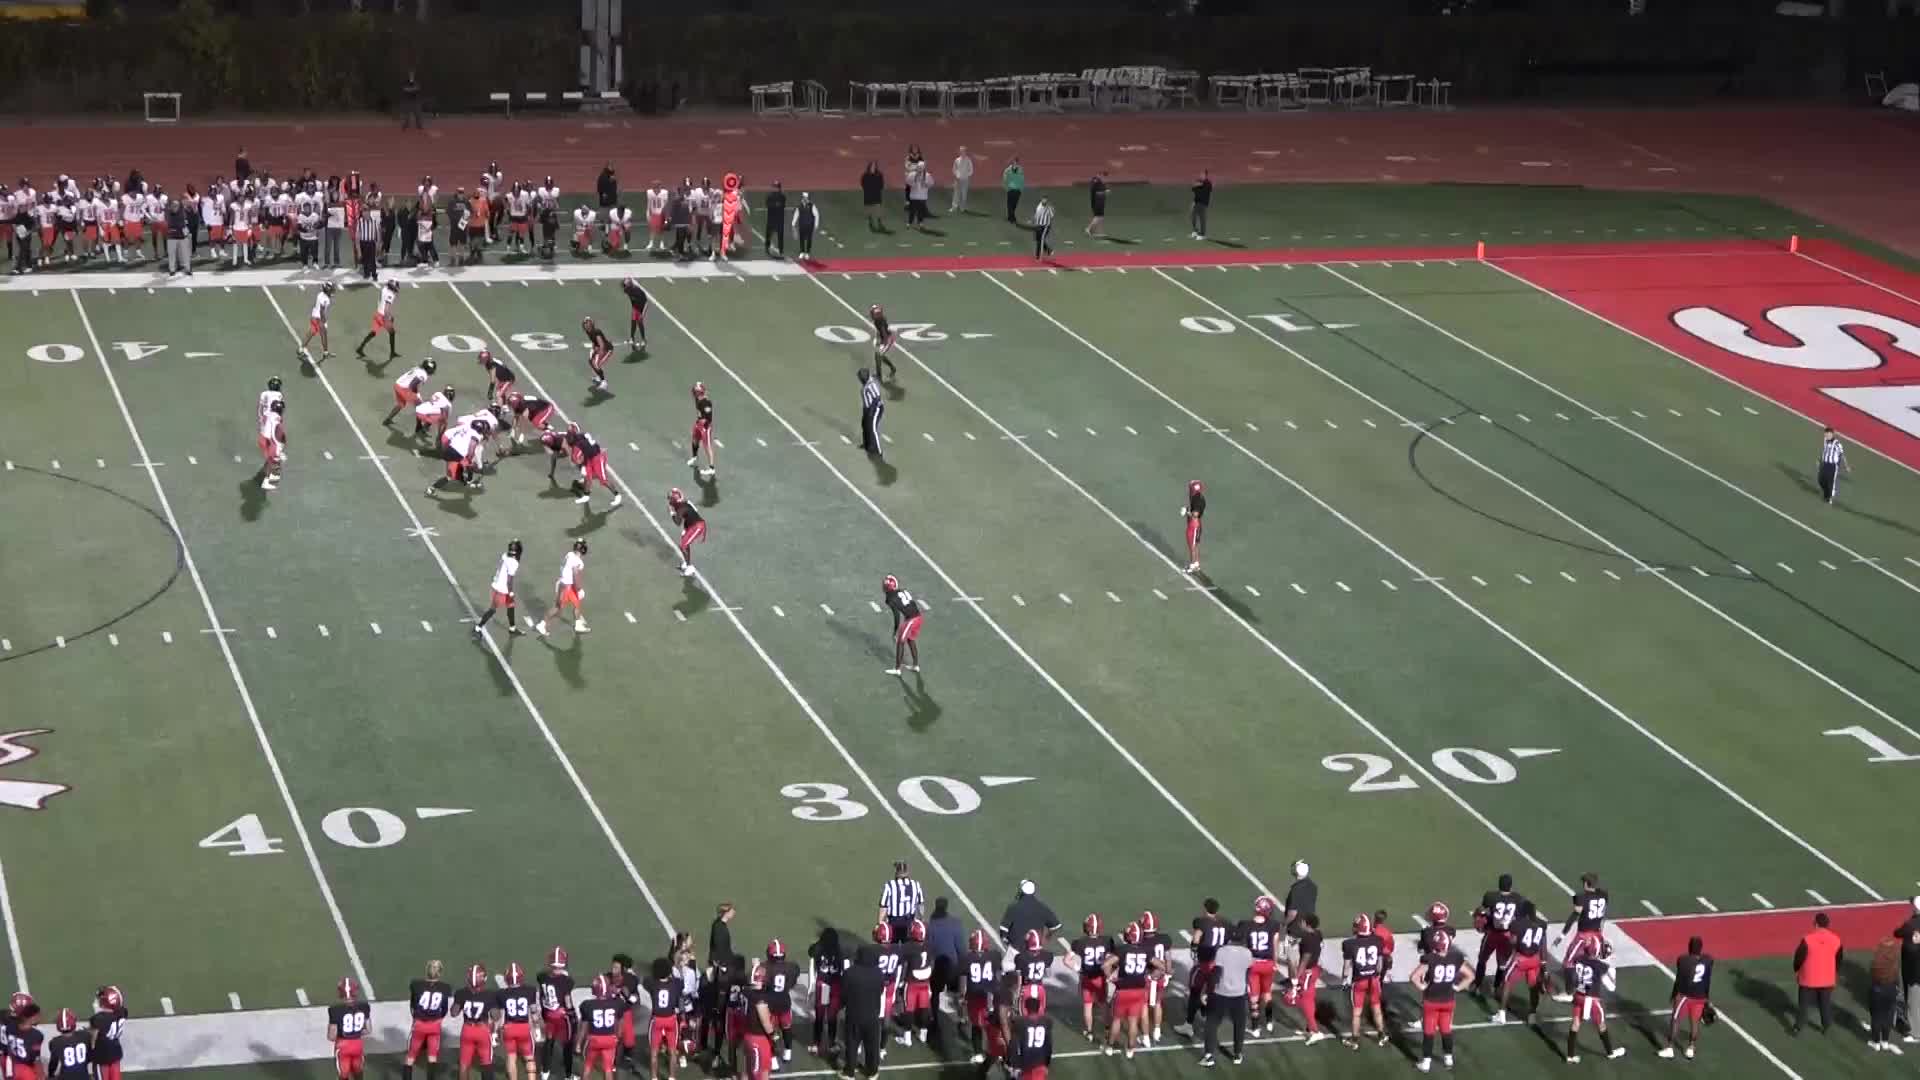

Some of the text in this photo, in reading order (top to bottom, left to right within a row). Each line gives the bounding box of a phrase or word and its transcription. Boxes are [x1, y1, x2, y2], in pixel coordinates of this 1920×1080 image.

[1250, 931, 1269, 950] 12
[1125, 953, 1147, 974] 55
[1356, 945, 1378, 966] 43
[970, 962, 993, 983] 94
[1028, 962, 1045, 980] 13
[1434, 964, 1456, 983] 99
[1693, 964, 1706, 983] 2
[592, 1008, 616, 1028] 56
[1027, 1026, 1046, 1047] 19
[63, 1042, 87, 1067] 80
